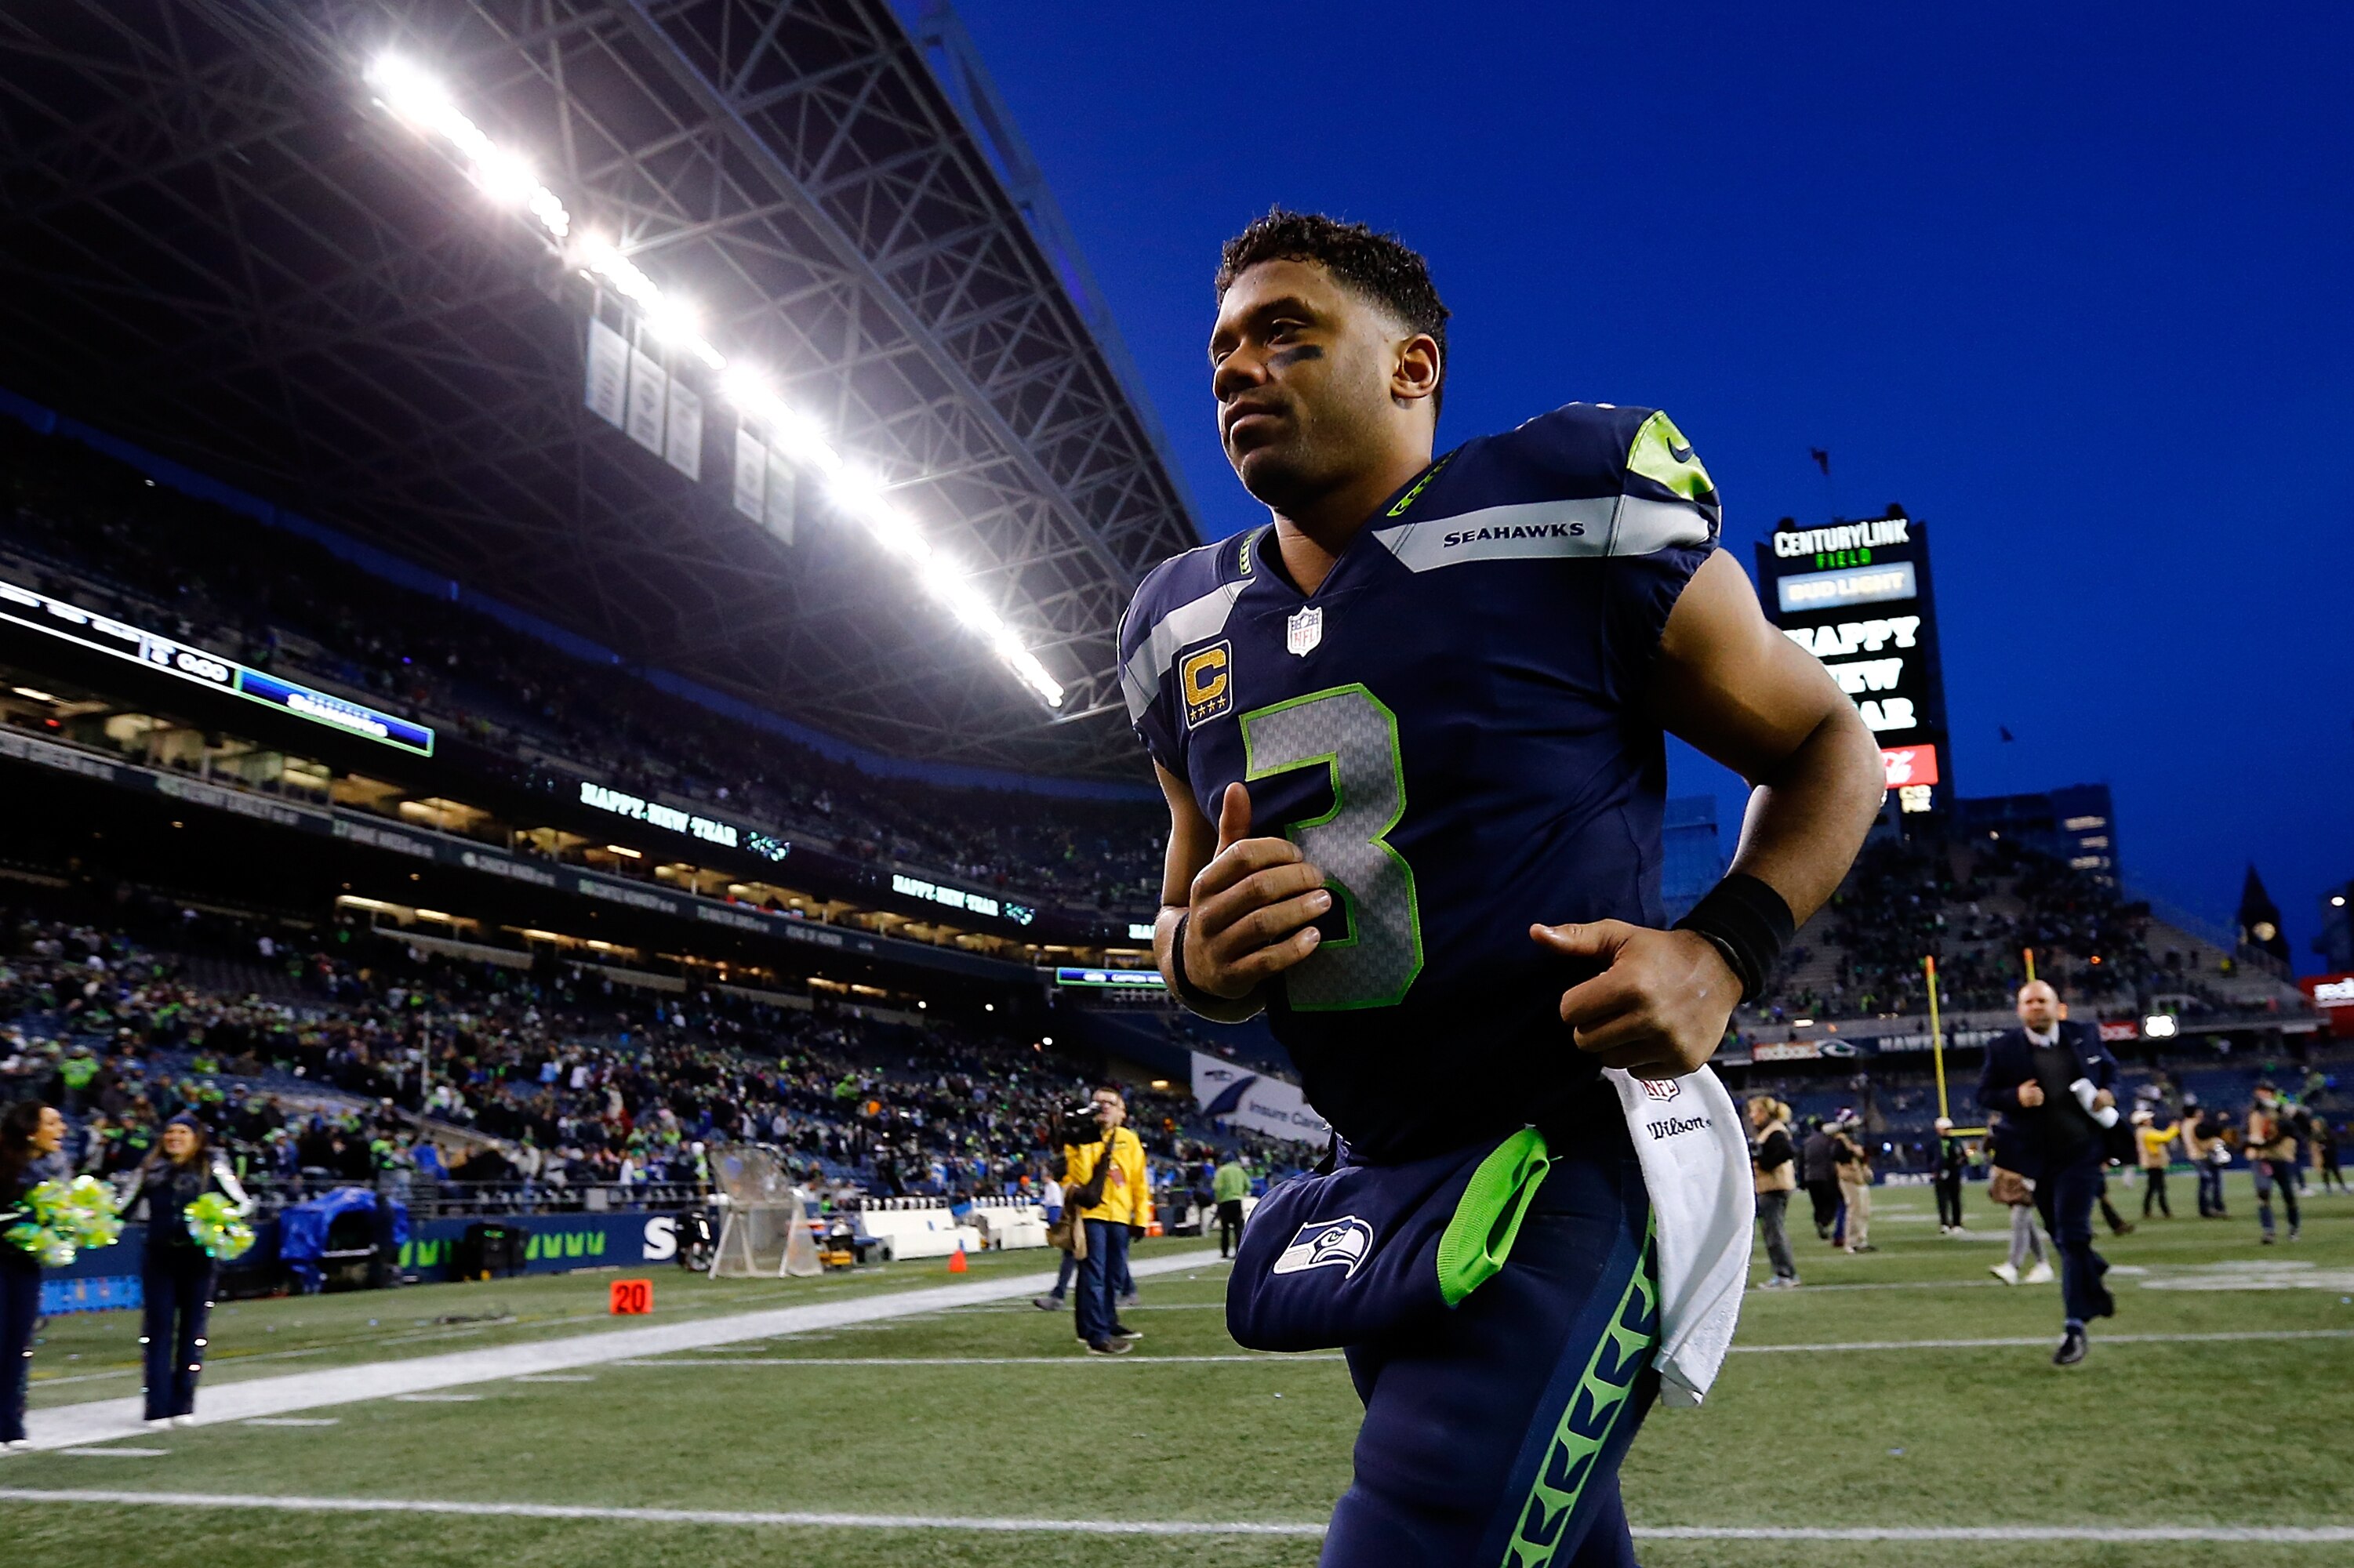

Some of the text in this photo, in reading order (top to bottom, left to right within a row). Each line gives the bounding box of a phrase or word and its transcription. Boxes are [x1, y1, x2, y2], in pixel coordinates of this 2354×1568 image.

[1443, 521, 1586, 548] SEAHAWKS
[1815, 547, 1872, 569] FIELD
[1294, 627, 1314, 647] NFL
[1184, 648, 1227, 706] C
[580, 782, 738, 848] HAPPY NEW YEAR
[1239, 682, 1424, 1011] 3
[892, 874, 935, 901] HAPPY
[965, 894, 999, 916] YEAR
[1642, 1079, 1676, 1097] NFL
[1647, 1117, 1706, 1140] Wilson
[615, 1283, 646, 1313] 20
